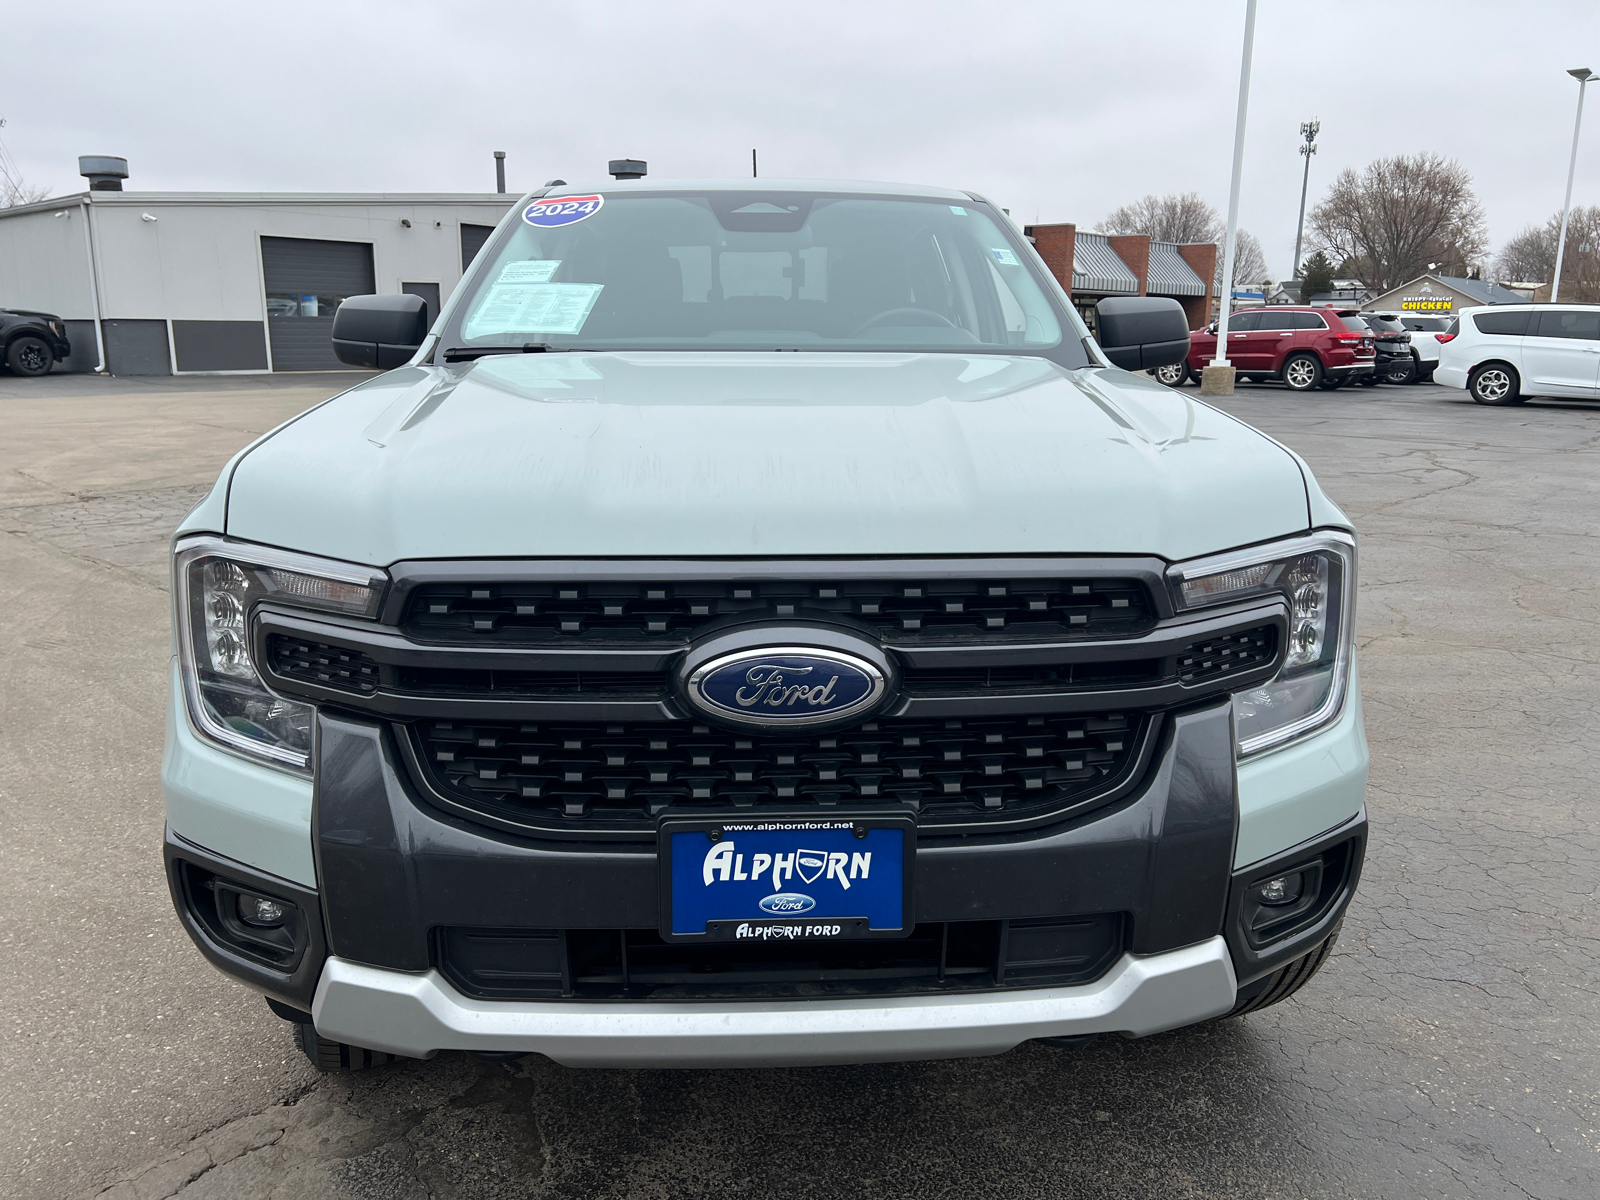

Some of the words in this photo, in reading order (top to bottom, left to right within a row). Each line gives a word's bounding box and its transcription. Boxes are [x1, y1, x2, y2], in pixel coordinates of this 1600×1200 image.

[527, 202, 595, 217] 2024
[1402, 302, 1452, 310] CHICKEN
[735, 664, 839, 707] Ford
[723, 822, 854, 831] www.alphornford.net
[771, 896, 804, 911] Ford
[805, 925, 841, 937] FORD
